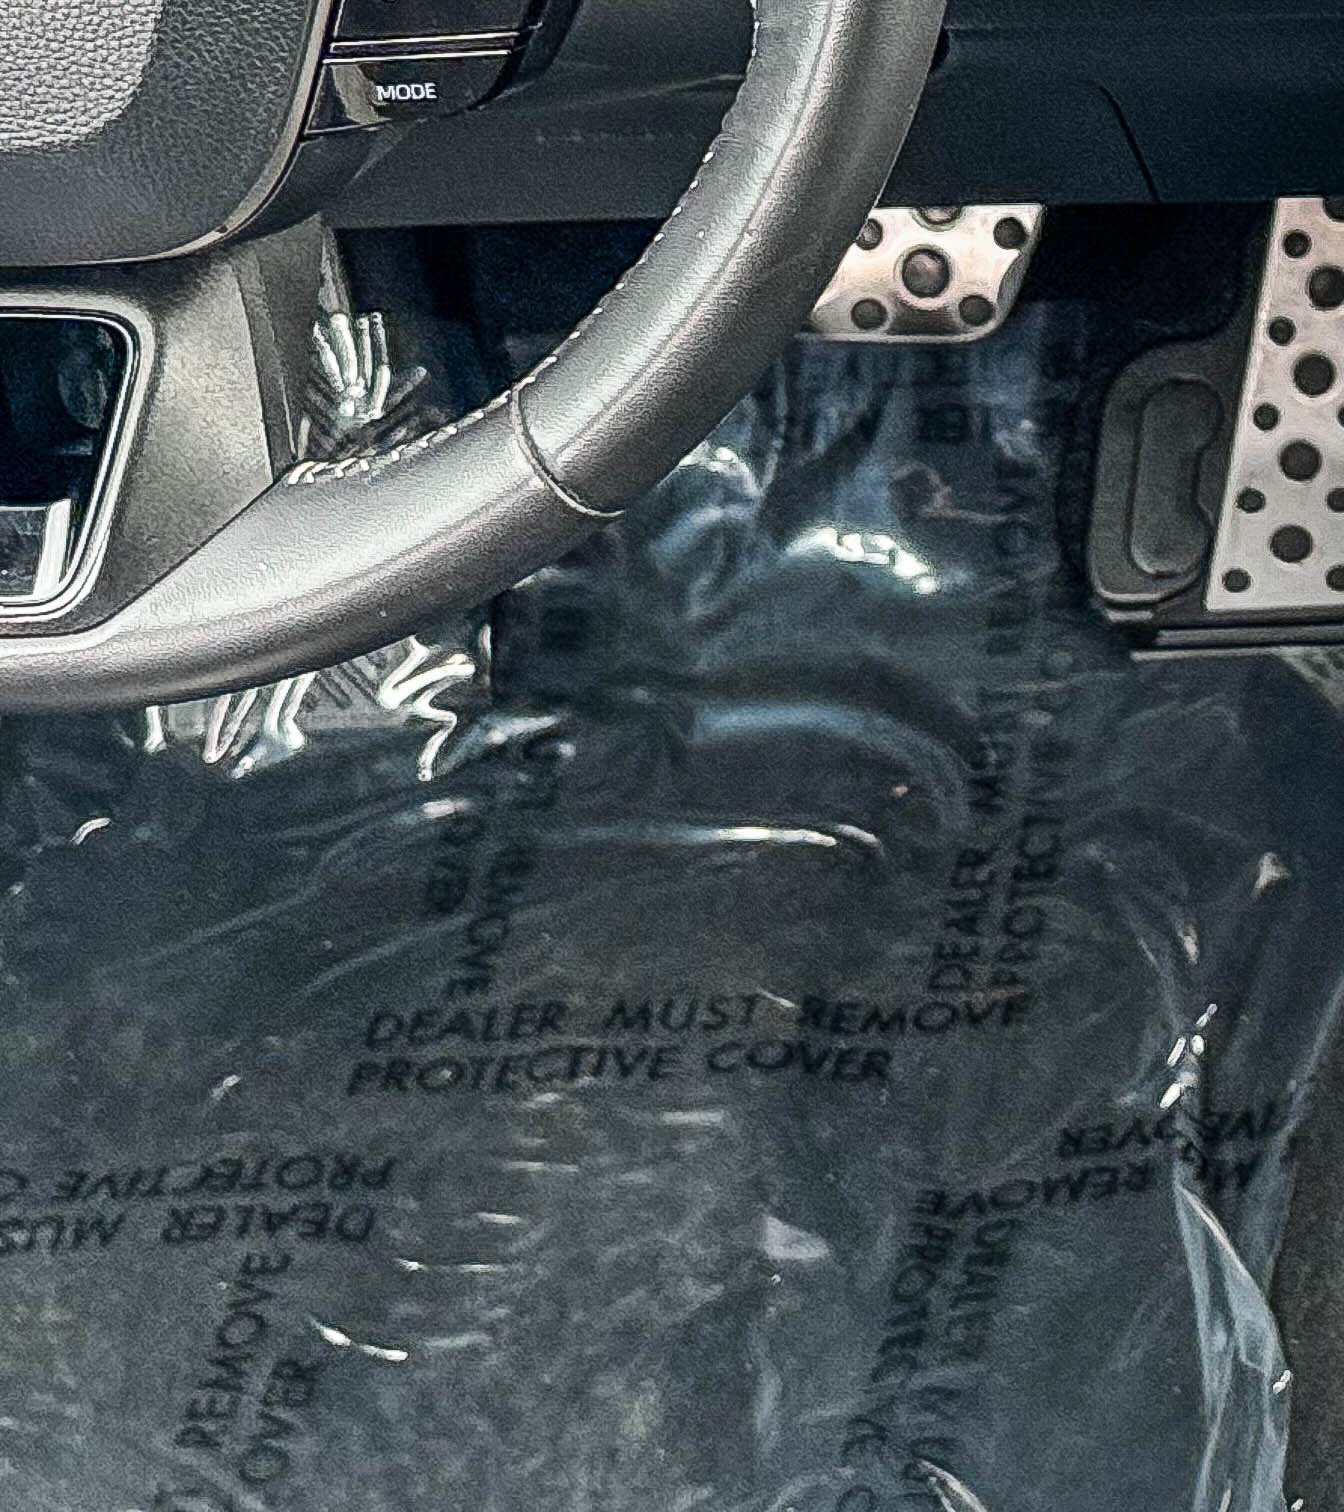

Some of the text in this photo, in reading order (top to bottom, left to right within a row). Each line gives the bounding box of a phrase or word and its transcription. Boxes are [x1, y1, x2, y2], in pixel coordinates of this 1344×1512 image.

[376, 80, 437, 100] MODE
[366, 999, 568, 1050] DEALER
[602, 993, 762, 1034] MUST
[347, 1039, 893, 1097] PROTECTIVE COVER
[159, 1202, 377, 1249] DEALER
[173, 1250, 293, 1454] REMOVE
[237, 1355, 324, 1486] OVER
